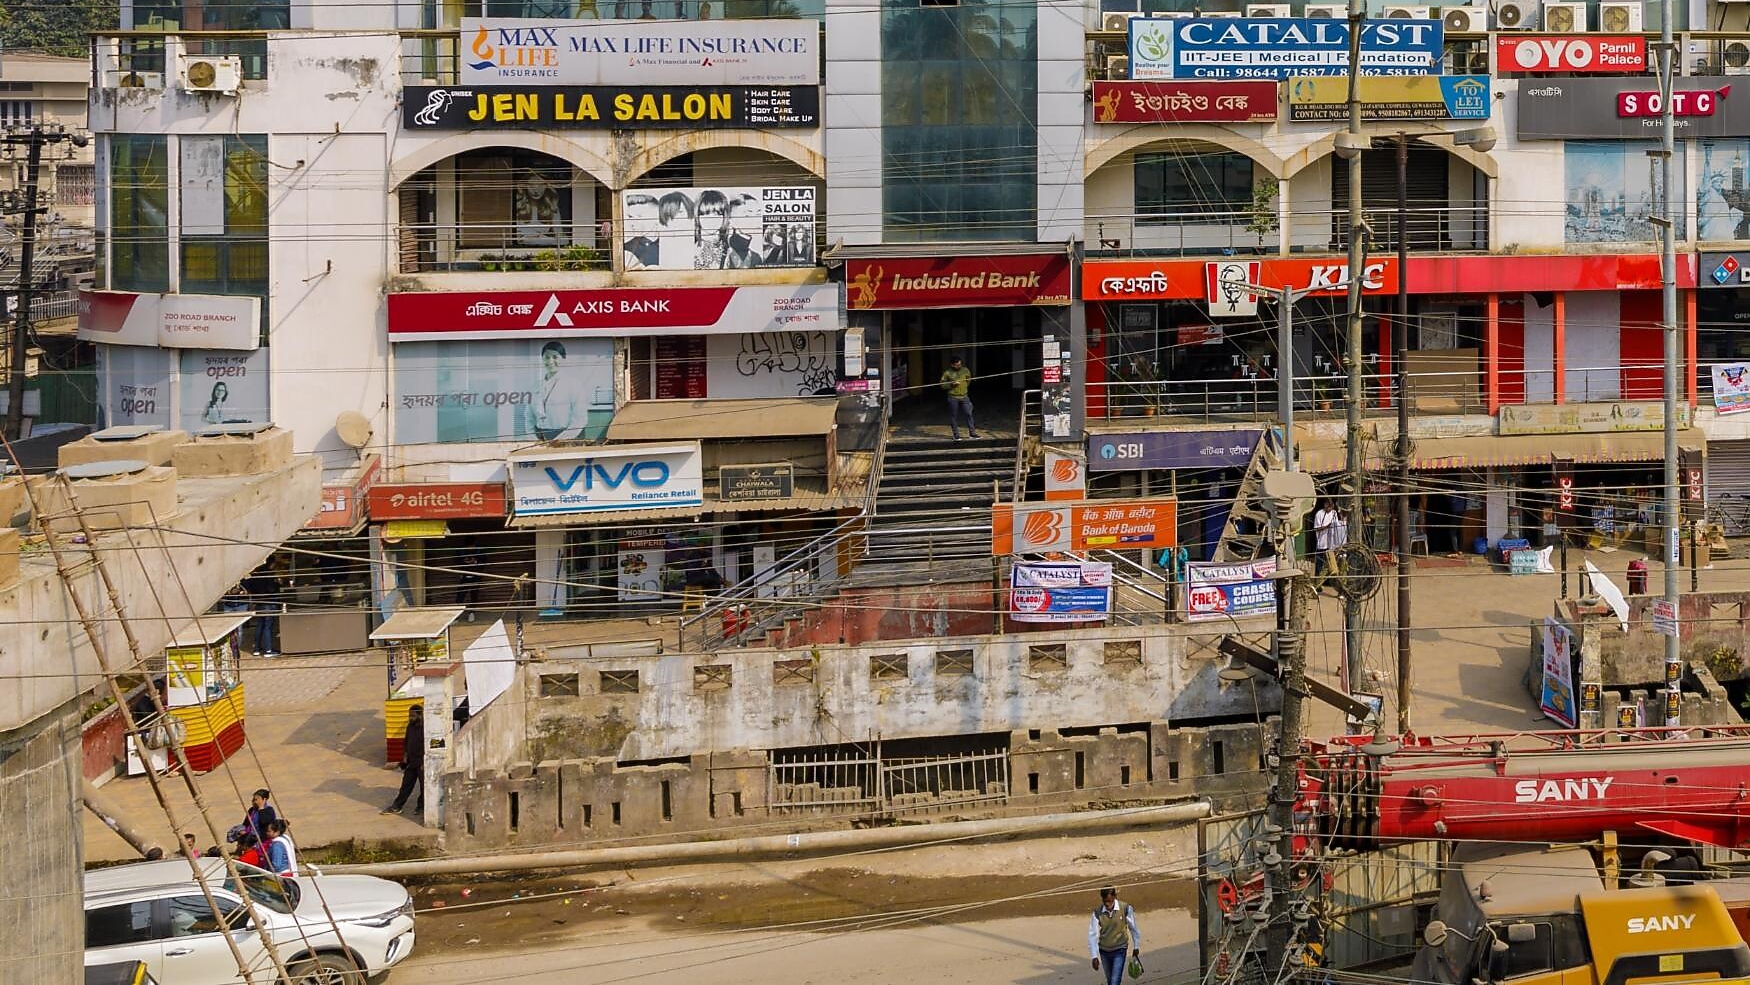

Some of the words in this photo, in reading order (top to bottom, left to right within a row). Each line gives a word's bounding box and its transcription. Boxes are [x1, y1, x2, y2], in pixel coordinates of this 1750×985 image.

[498, 28, 559, 46] MAX
[569, 37, 616, 53] MAX
[623, 37, 673, 54] LIFE
[679, 37, 806, 54] INSURANCE
[1600, 42, 1636, 53] Parnil
[498, 48, 560, 67] LIFE
[1185, 52, 1243, 62] IIT-JEE
[1260, 52, 1321, 62] Medical
[1337, 52, 1427, 63] Fundation
[1514, 40, 1593, 68] OYO
[1600, 54, 1642, 65] Palace
[498, 69, 559, 77] INSURANCE
[1195, 68, 1231, 77] Call:
[1236, 68, 1278, 77] 98644
[1283, 68, 1325, 77] 71587
[1462, 86, 1477, 96] TO
[468, 94, 538, 121] JEN
[555, 94, 600, 120] LA
[614, 94, 732, 121] SALON
[1458, 97, 1481, 107] LET
[1295, 110, 1328, 119] CONTACT
[764, 190, 791, 200] JEN
[795, 190, 812, 200] LA
[765, 204, 811, 213] SALON
[892, 272, 985, 290] IndusInd
[988, 271, 1041, 288] Bank
[573, 300, 614, 314] AXIS
[620, 299, 671, 313] BANK
[203, 314, 236, 322] BRANCH
[207, 365, 247, 380] open
[483, 391, 532, 408] open
[121, 398, 156, 417] open
[1117, 443, 1144, 458] SBI
[1691, 471, 1702, 500] KFC
[408, 491, 453, 507] airtel
[461, 491, 484, 506] 4G
[632, 490, 669, 500] Reliance
[671, 489, 697, 498] Retail
[1561, 479, 1573, 509] KFC
[1082, 523, 1109, 536] Bank
[1109, 522, 1119, 535] of
[1120, 522, 1156, 535] Baroda
[1030, 569, 1078, 579] CATALYST
[1202, 566, 1250, 578] CATALYST
[1233, 582, 1275, 596] CRASH
[1192, 592, 1217, 605] FREE
[1233, 592, 1275, 605] COURSE
[1515, 777, 1614, 803] SANY
[1627, 914, 1696, 933] SANY
